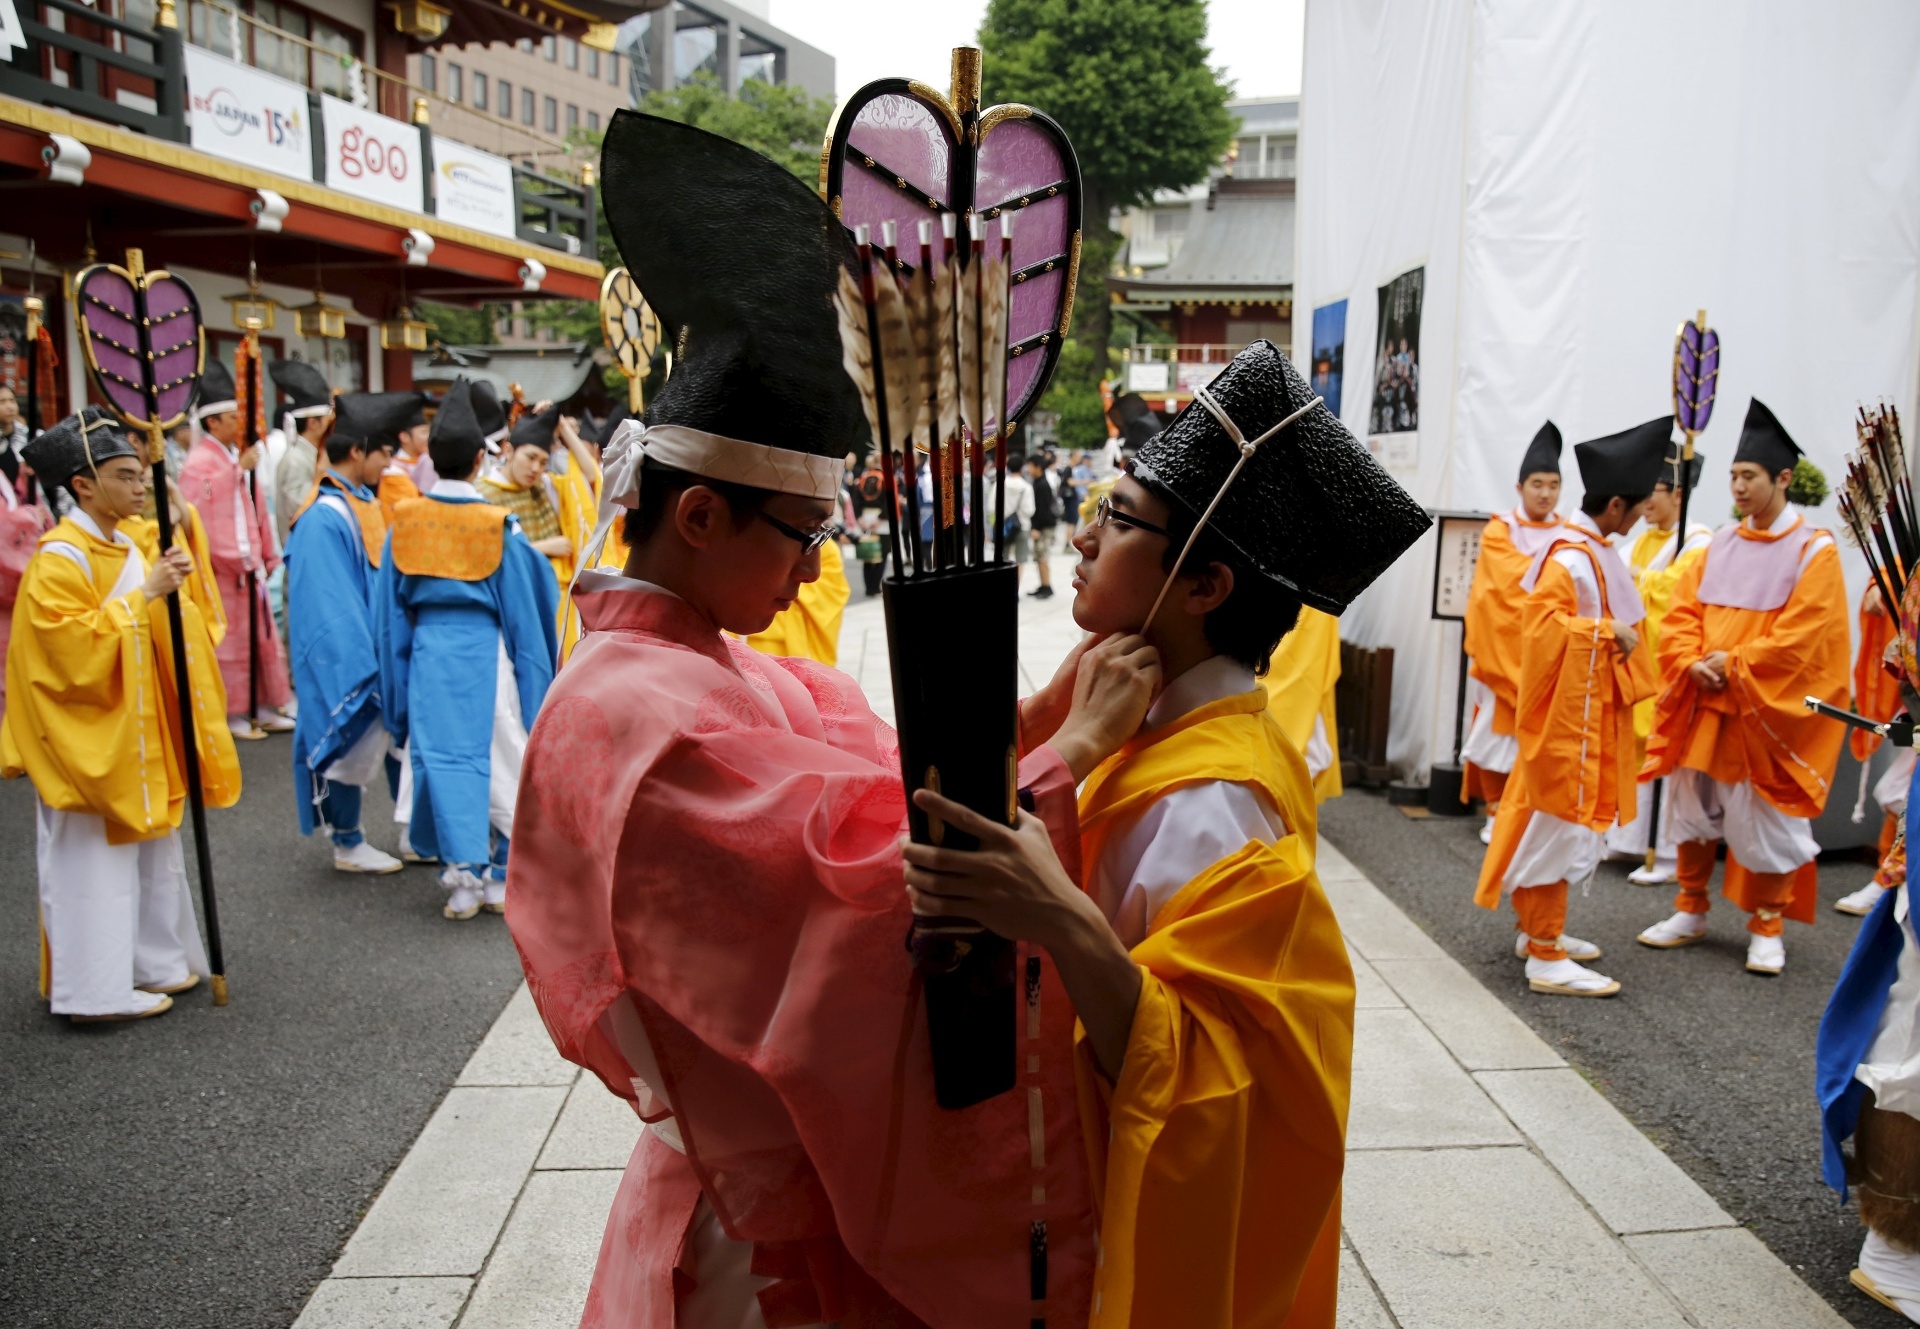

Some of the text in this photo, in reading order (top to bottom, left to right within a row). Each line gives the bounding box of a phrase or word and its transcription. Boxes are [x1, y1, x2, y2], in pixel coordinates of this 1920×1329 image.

[216, 105, 260, 127] JAPAN
[265, 109, 285, 144] 15
[340, 125, 408, 182] goo
